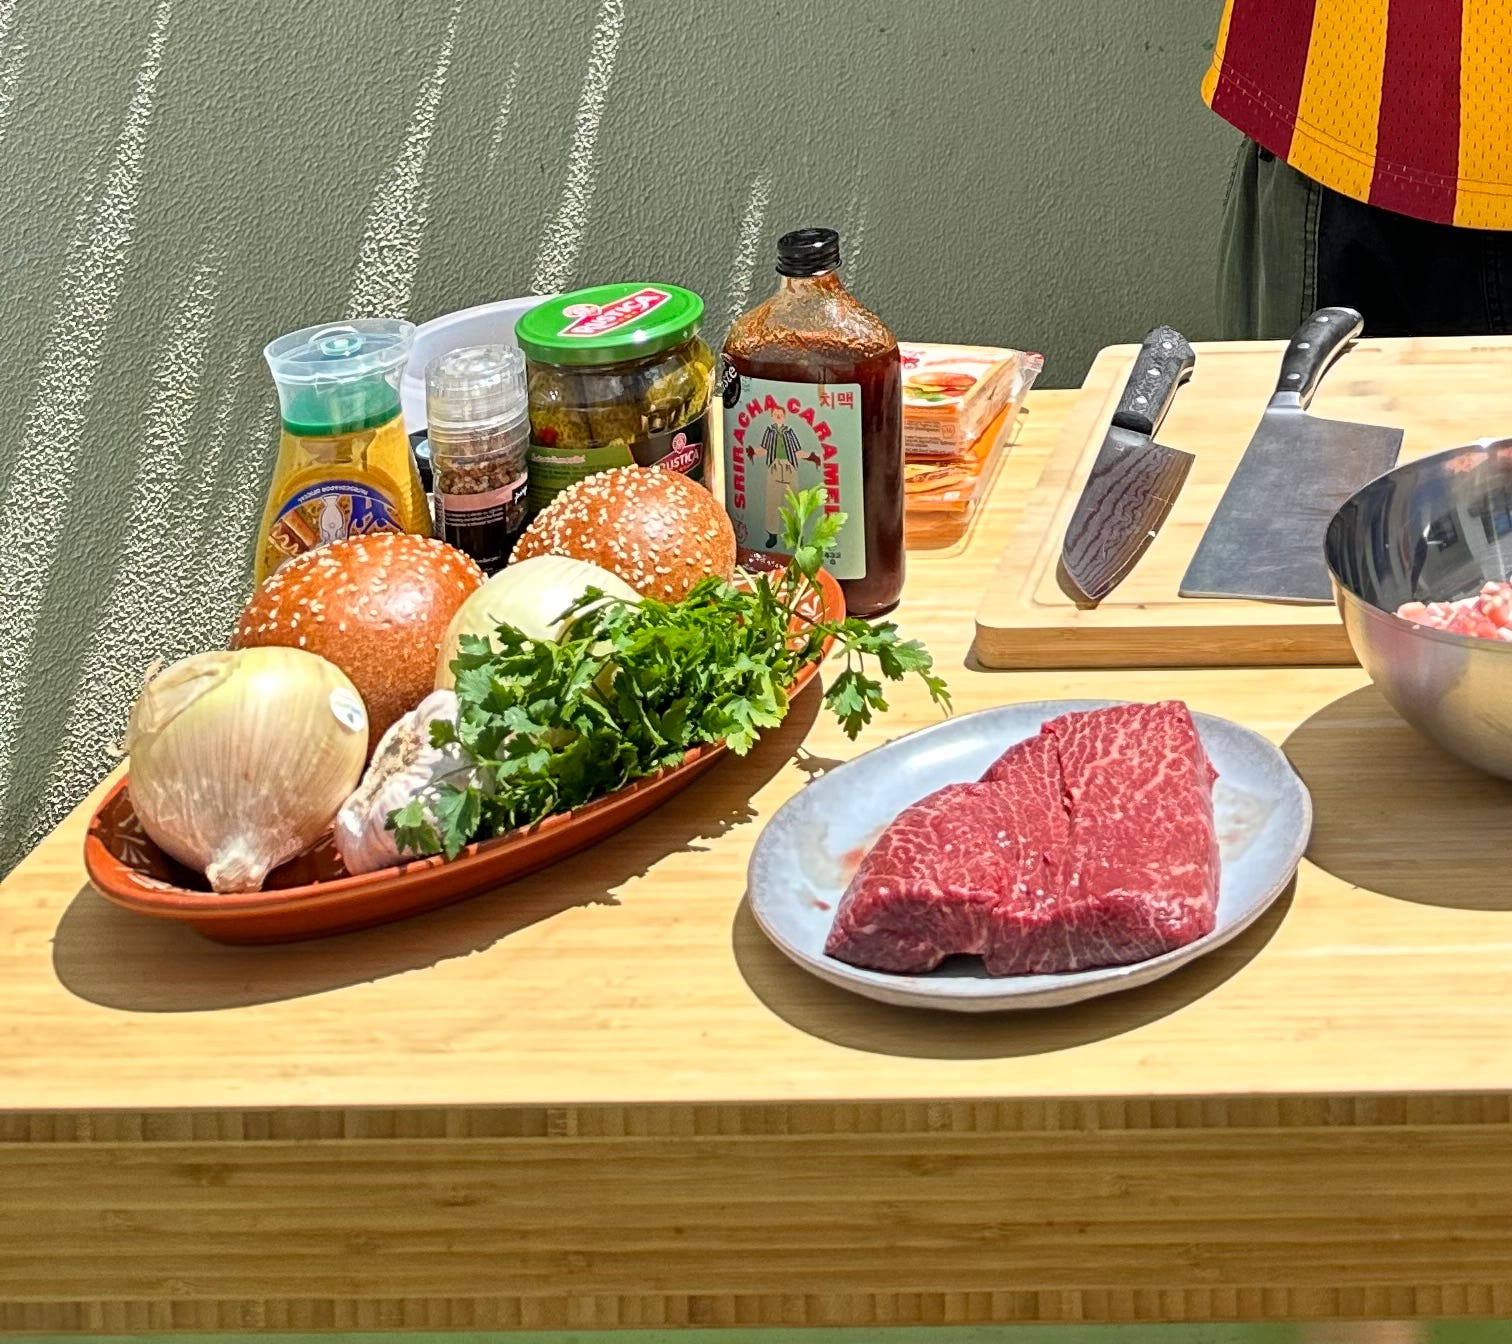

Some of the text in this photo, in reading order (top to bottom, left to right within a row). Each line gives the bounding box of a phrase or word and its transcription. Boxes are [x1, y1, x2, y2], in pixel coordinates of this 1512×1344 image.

[570, 295, 660, 334] RUSTICA
[819, 391, 854, 410] 치맥
[731, 394, 778, 510] SRIRACHA
